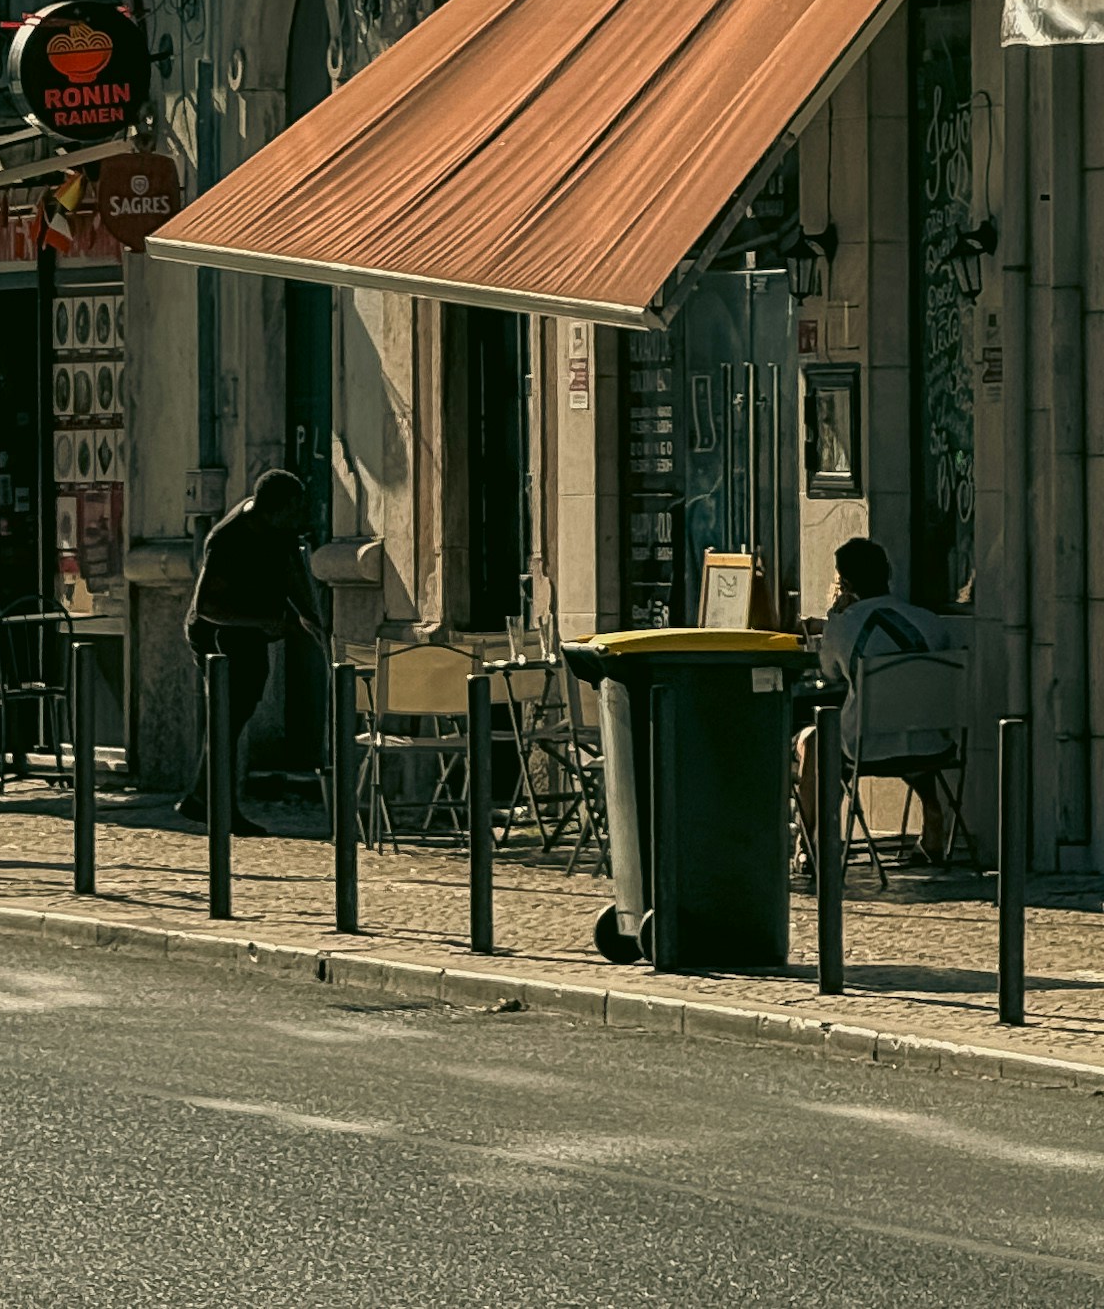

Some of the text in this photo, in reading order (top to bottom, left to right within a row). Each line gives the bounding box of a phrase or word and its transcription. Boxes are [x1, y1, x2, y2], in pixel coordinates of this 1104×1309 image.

[44, 83, 131, 109] RONIN
[54, 107, 125, 126] RAMEN
[109, 195, 171, 217] SAGRES
